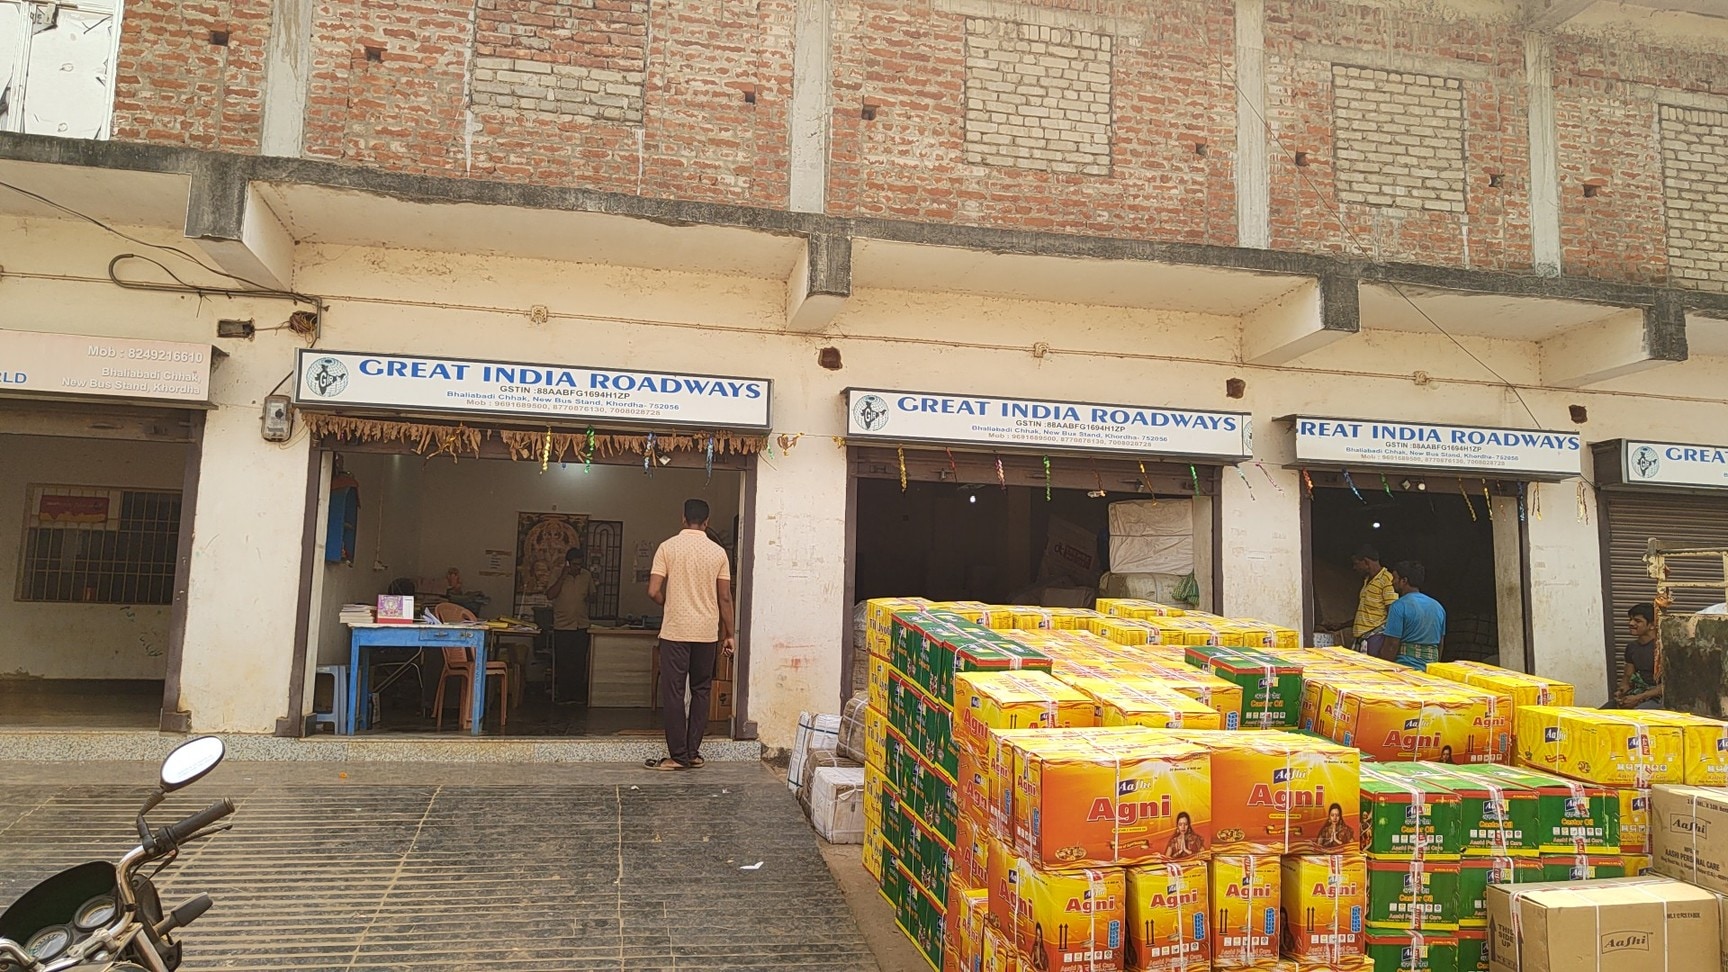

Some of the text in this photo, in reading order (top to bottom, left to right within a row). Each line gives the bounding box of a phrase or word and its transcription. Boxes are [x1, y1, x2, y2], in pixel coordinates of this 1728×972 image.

[88, 345, 116, 357] Mob
[128, 348, 203, 363] 8249216610
[0, 372, 27, 384] LD
[101, 367, 201, 382] Bhaliabadi Chhak,
[359, 359, 761, 399] GREAT INDIA ROADWAYS
[61, 377, 200, 394] New Bus Stand, Khordha
[499, 385, 531, 394] GSTIN
[447, 391, 495, 400] Bhaliabadi
[498, 394, 530, 403] Chhak,
[649, 403, 680, 411] 752056
[897, 396, 1237, 432] GREAT INDIA ROADWAYS
[1015, 420, 1041, 428] GSTIN
[1296, 421, 1580, 450] REAT INDIA ROADWAYS
[1665, 447, 1728, 464] GREA
[963, 708, 989, 740] Agni
[1473, 716, 1505, 728] Agni
[1383, 730, 1442, 751] Agni
[990, 757, 1009, 778] Agni
[1017, 775, 1036, 797] Agni
[1247, 784, 1325, 811] Agni
[1087, 794, 1171, 825] Agni
[999, 877, 1035, 924] Agni
[1150, 889, 1198, 909] Agni
[1225, 883, 1272, 900] Agni
[1312, 883, 1357, 900] Agni
[1064, 896, 1115, 914] Agni
[1498, 931, 1514, 943] SIDE
[1501, 939, 1511, 948] UP
